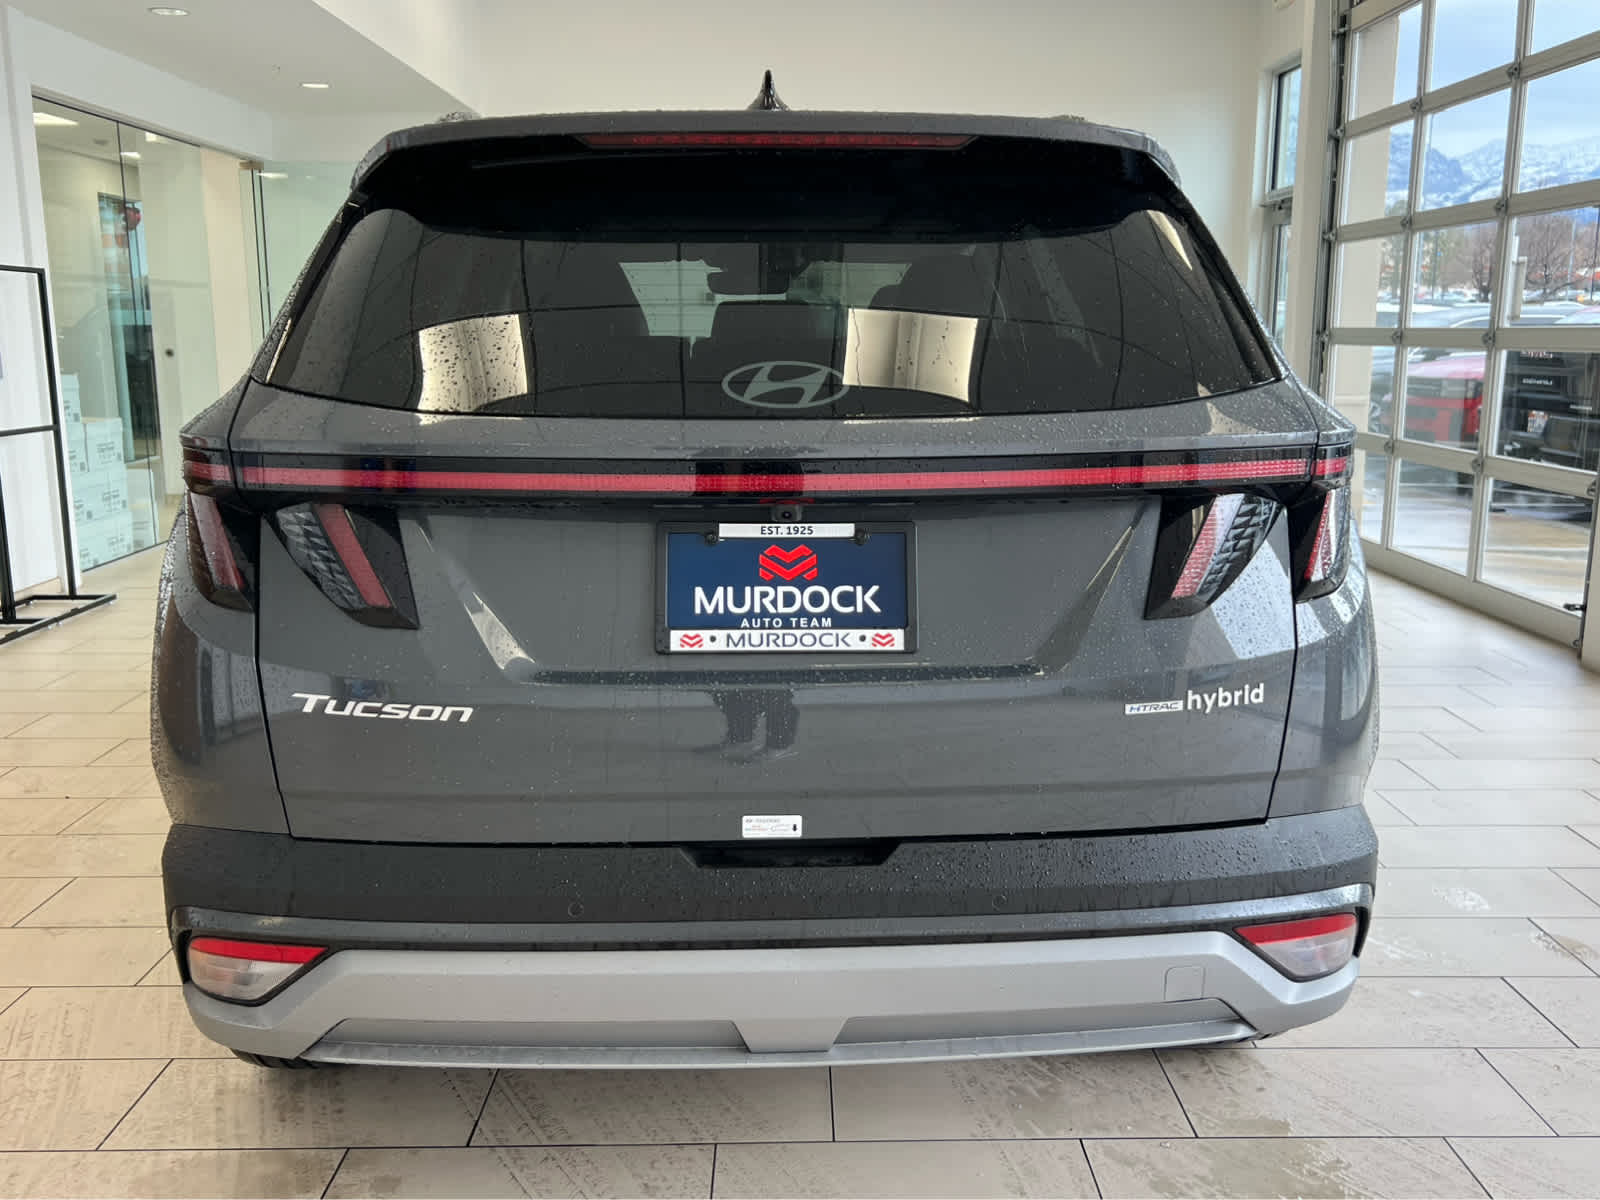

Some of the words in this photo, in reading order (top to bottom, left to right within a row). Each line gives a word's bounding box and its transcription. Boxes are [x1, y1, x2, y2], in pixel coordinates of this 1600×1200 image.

[760, 526, 784, 536] EST.
[786, 526, 814, 535] 1925
[694, 585, 882, 614] MURDOCK
[740, 617, 783, 628] AUTO
[790, 617, 832, 627] TEAM
[726, 632, 852, 648] MURDOCK
[1128, 702, 1180, 713] HTRAC
[1187, 683, 1265, 714] hybrid
